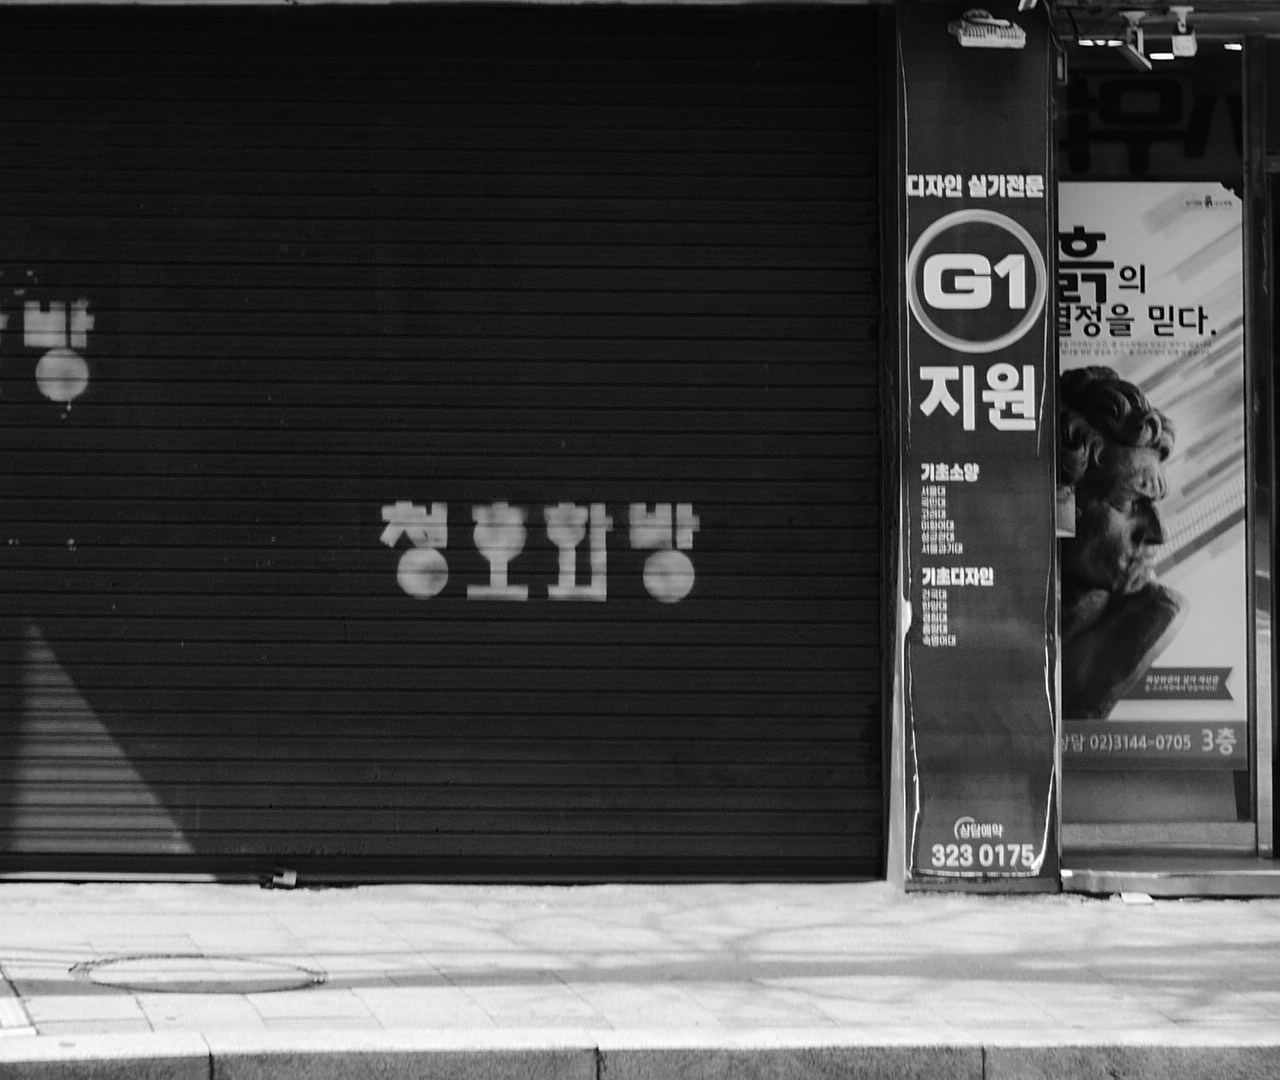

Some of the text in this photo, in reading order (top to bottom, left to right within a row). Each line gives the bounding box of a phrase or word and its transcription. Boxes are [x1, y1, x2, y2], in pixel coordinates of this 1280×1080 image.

[907, 174, 1044, 198] 디자인 실기전문
[923, 253, 1026, 310] G1
[1148, 304, 1217, 337] 믿다.
[919, 362, 1037, 431] 지원
[920, 462, 980, 483] 기초소양
[921, 566, 995, 587] 기초디자인
[1089, 734, 1192, 755] 02)3144-0705
[1201, 726, 1238, 757] 3층
[959, 822, 1004, 839] 상담예약
[931, 843, 1036, 868] 323 0175
